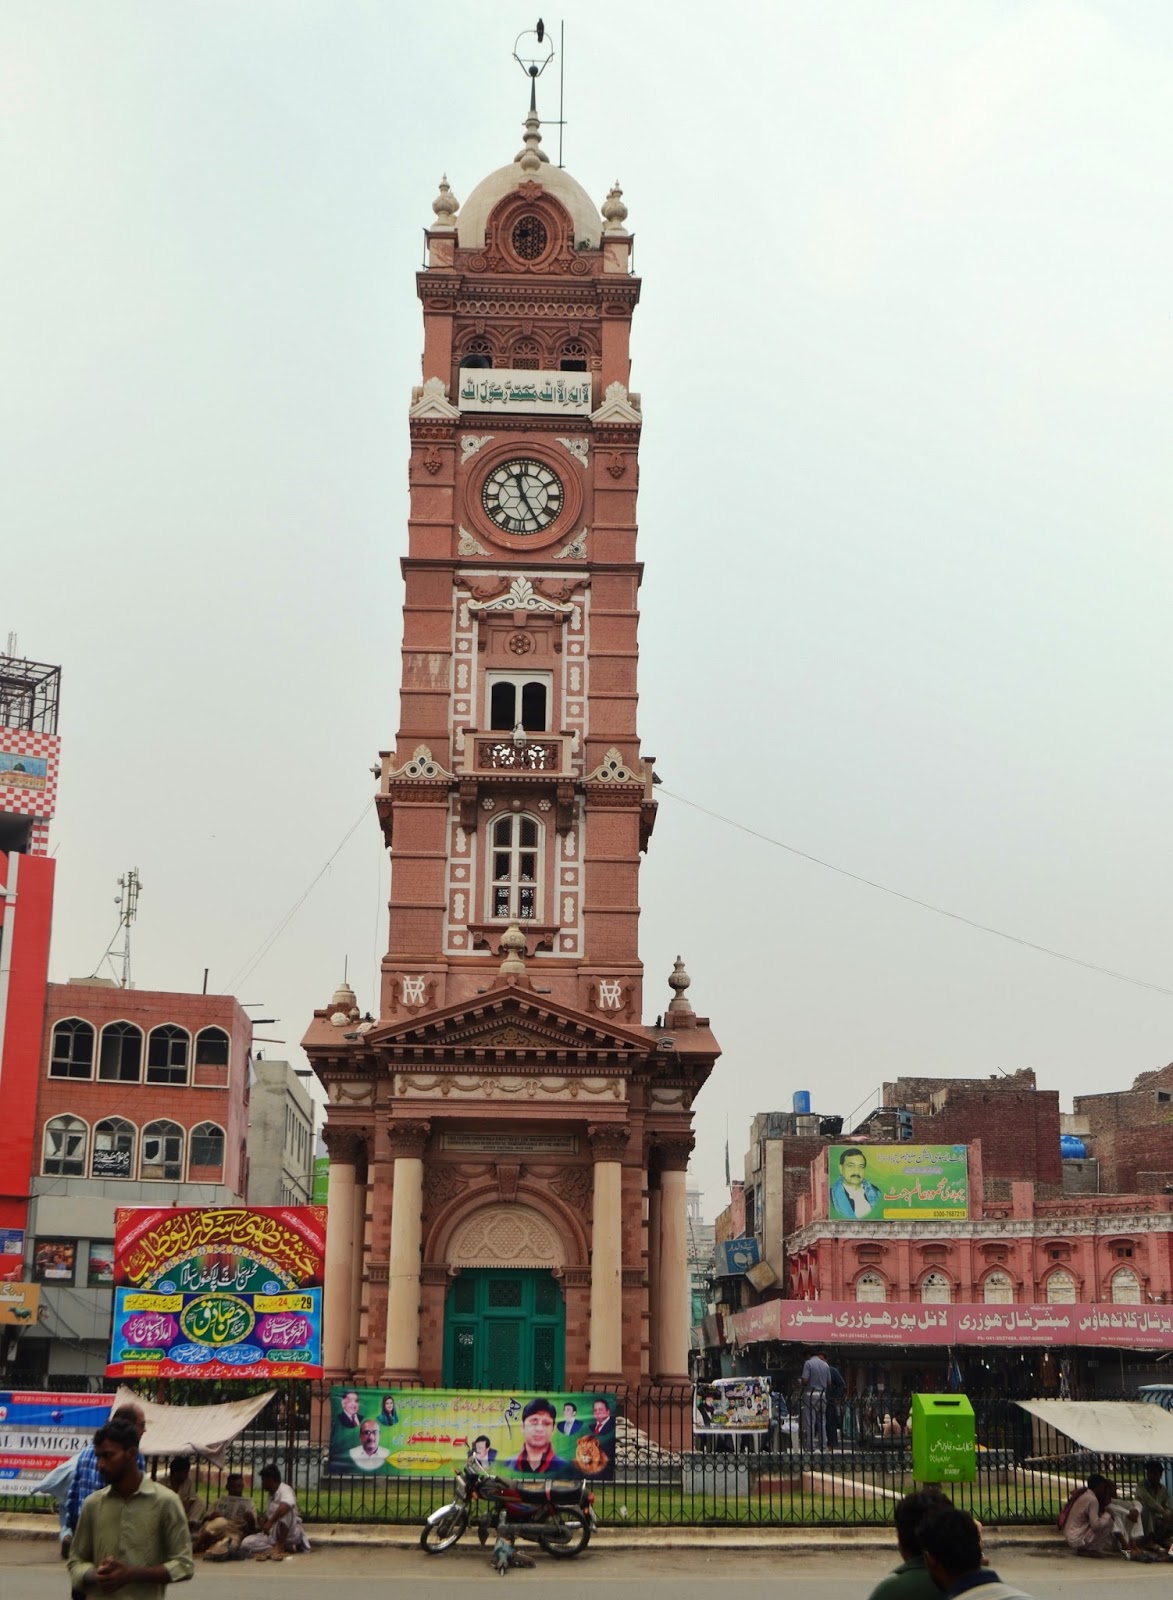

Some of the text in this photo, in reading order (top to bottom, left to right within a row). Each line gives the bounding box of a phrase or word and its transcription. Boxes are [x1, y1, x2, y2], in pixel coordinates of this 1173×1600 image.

[279, 1298, 287, 1306] 24
[301, 1297, 312, 1309] 29
[787, 1306, 834, 1328] سٹور
[14, 1395, 59, 1403] INTERNATIONAL
[20, 1436, 93, 1450] IMMIGRA
[407, 1431, 437, 1446] مشکور
